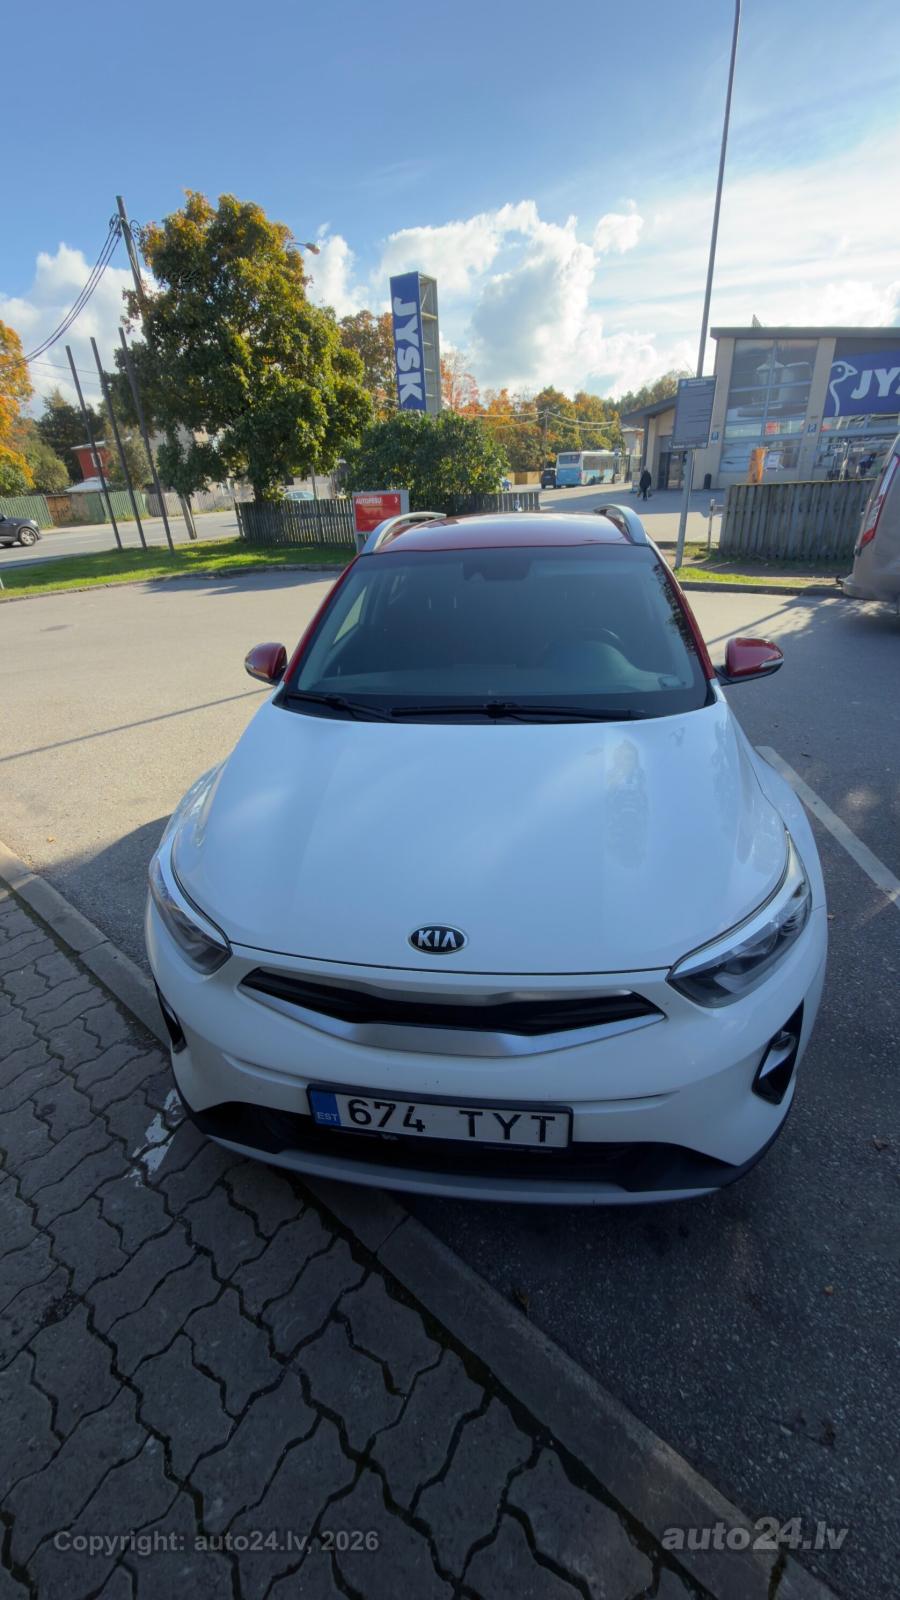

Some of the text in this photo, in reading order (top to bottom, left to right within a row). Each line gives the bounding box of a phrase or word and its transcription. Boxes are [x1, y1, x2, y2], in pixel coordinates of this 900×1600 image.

[393, 297, 423, 404] JYSK
[850, 366, 900, 400] JY
[417, 930, 457, 949] KIA
[316, 1111, 338, 1122] EST
[347, 1098, 556, 1144] 674 TYT
